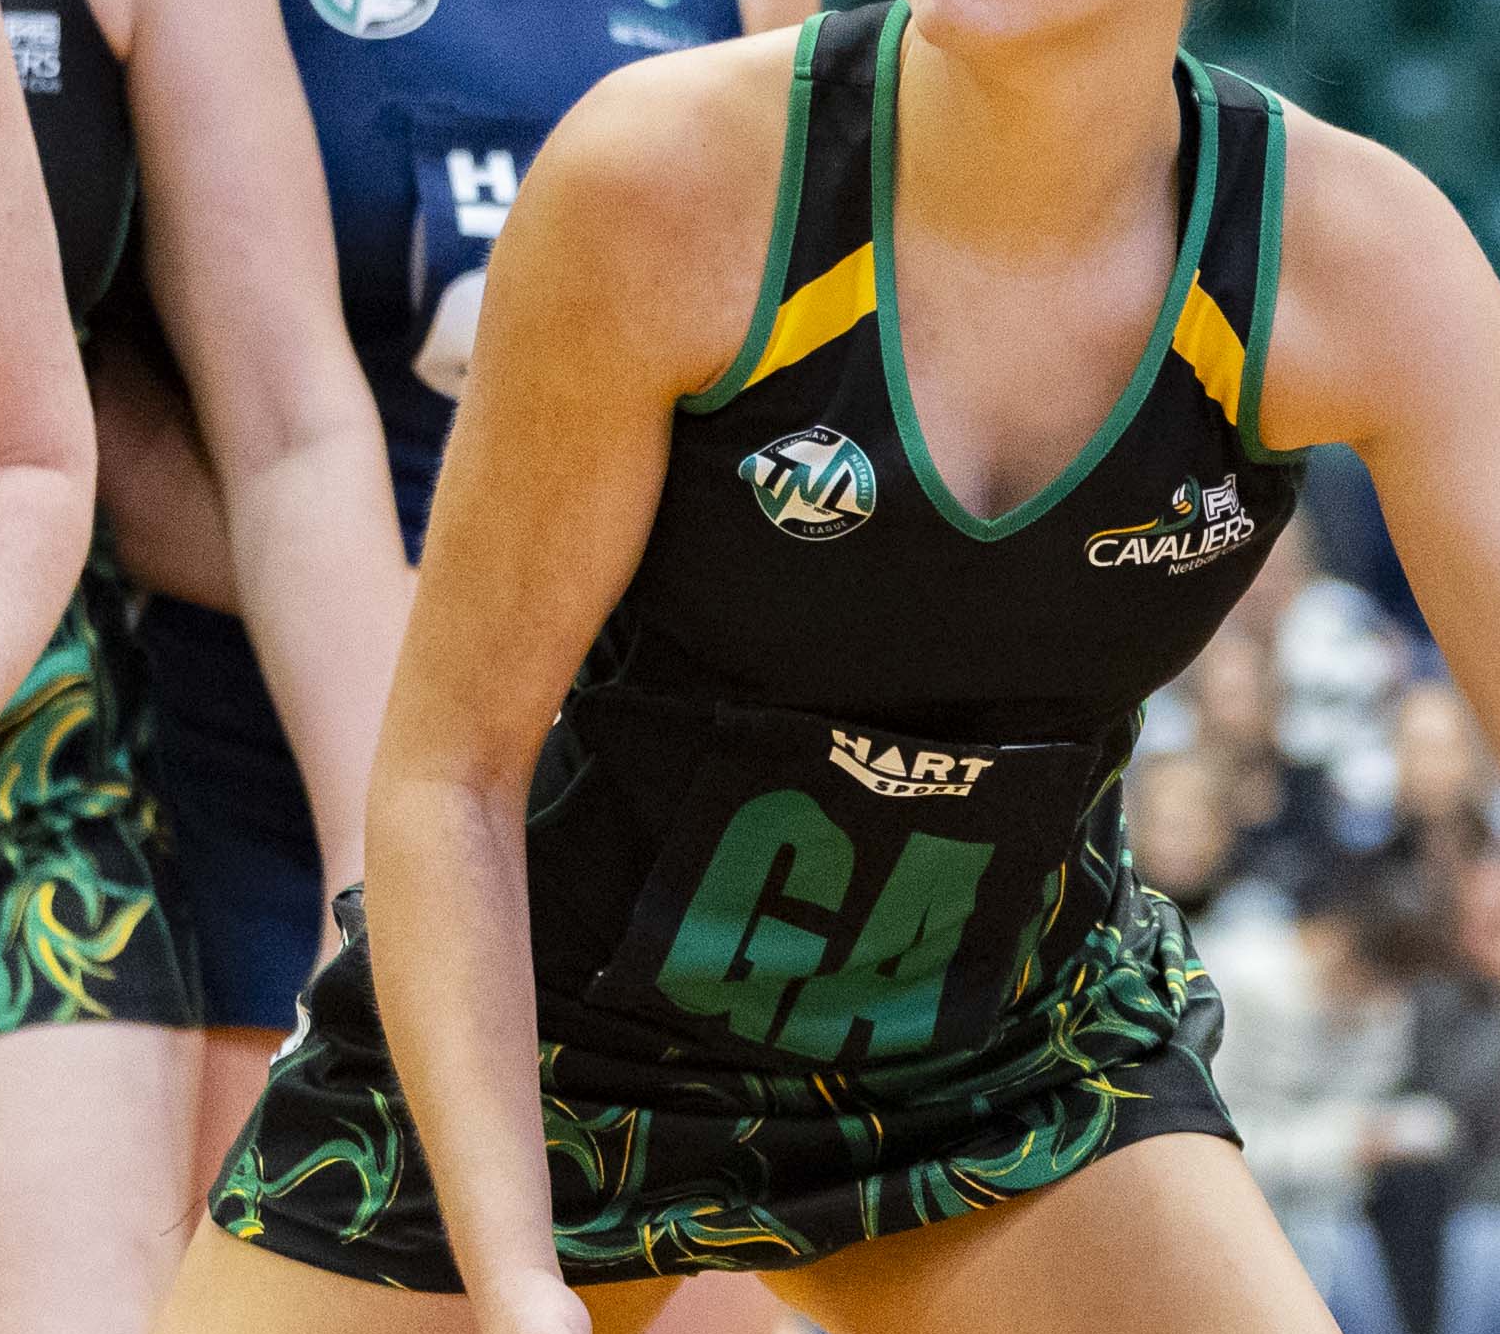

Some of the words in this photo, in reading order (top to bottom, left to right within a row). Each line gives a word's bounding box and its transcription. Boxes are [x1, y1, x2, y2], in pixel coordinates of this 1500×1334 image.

[1087, 508, 1255, 567] CAVALIERS
[831, 729, 995, 782] HART
[874, 779, 968, 795] SPORT
[655, 788, 996, 1062] GA
